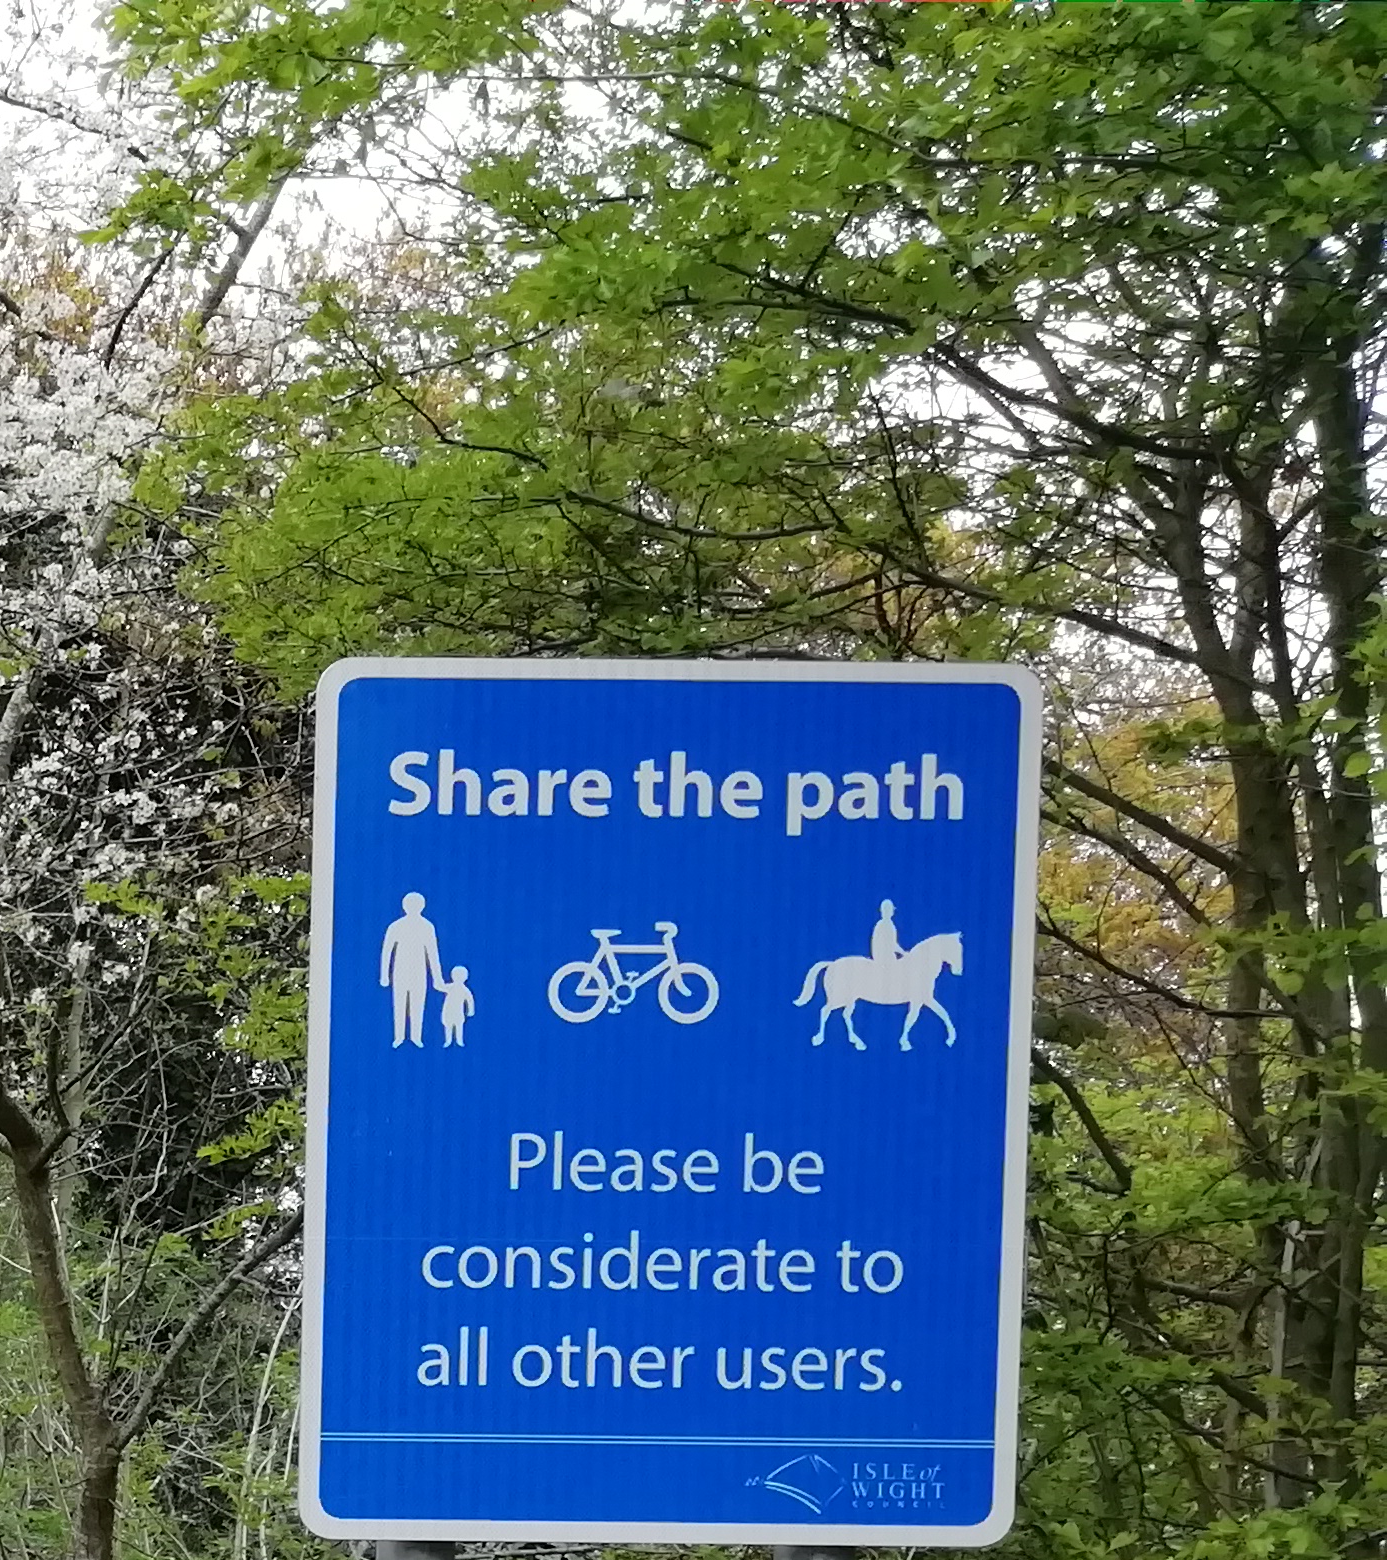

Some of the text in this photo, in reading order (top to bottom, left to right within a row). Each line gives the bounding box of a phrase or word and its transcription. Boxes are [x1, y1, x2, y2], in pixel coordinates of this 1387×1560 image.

[388, 749, 964, 836] Share the path
[509, 1131, 825, 1194] Please be
[421, 1230, 904, 1294] considerate to
[417, 1326, 902, 1392] all other users.
[851, 1481, 945, 1500] WIGHT
[852, 1462, 941, 1483] ISLE of
